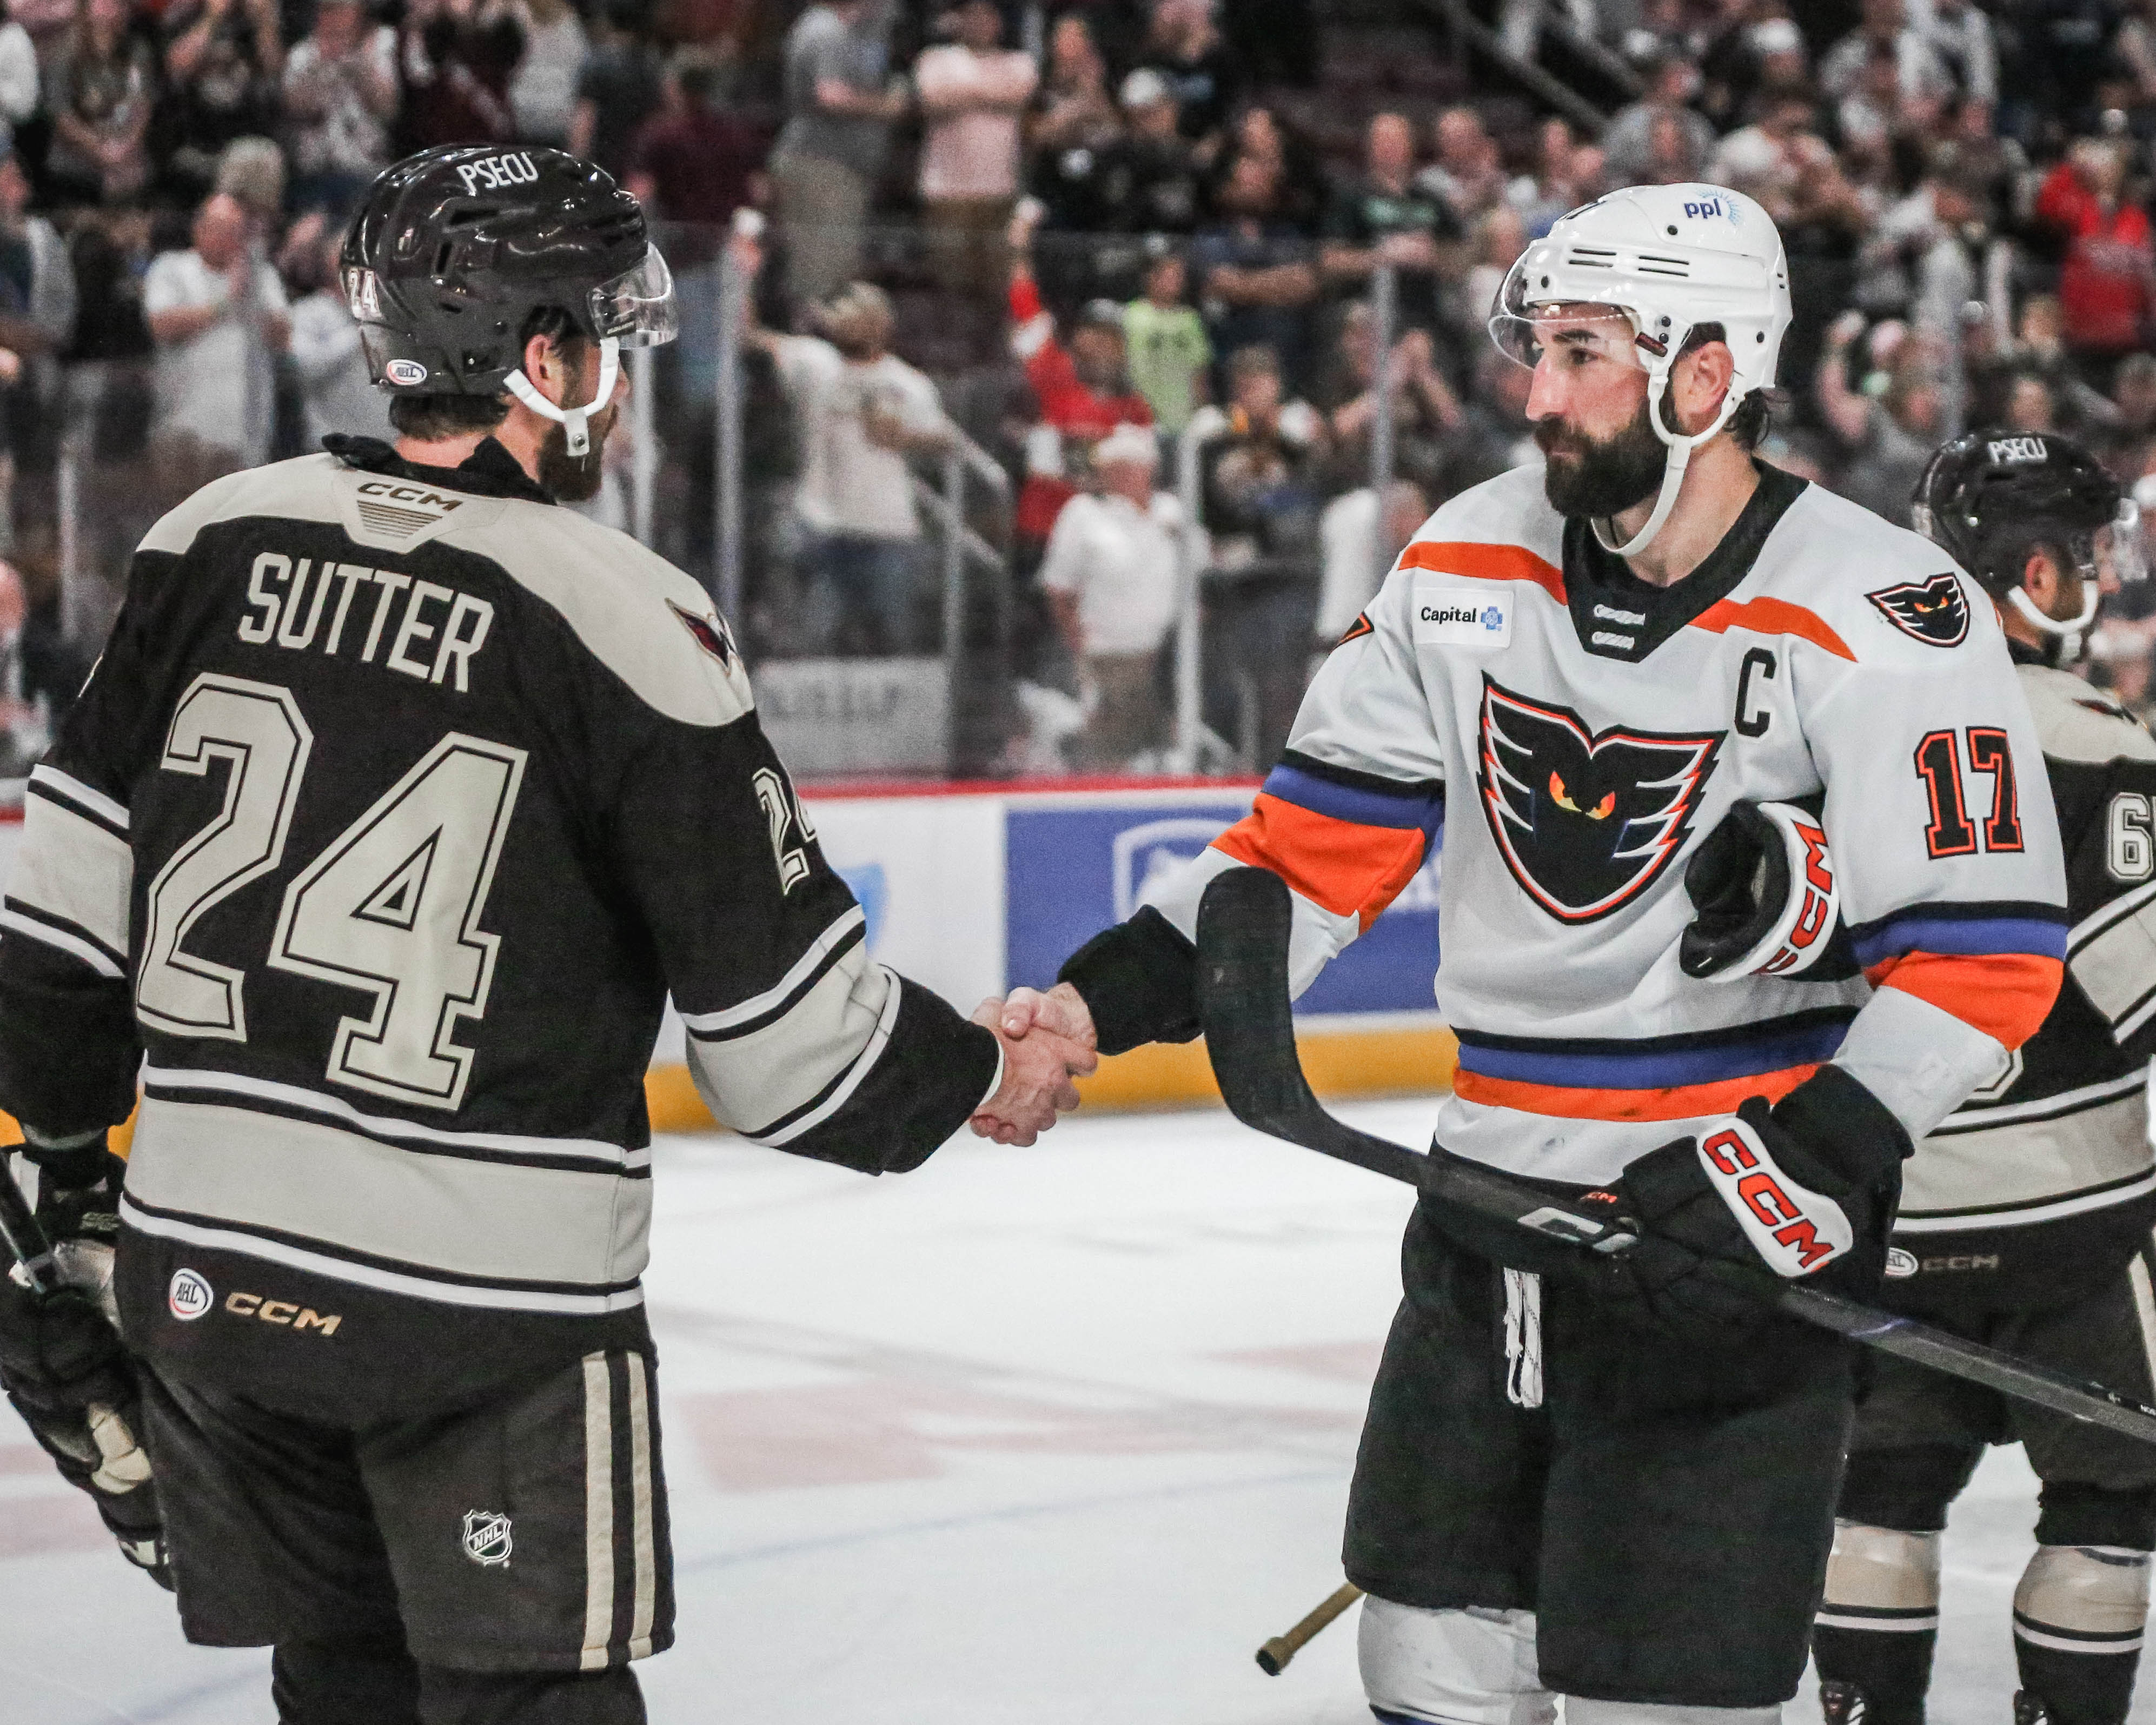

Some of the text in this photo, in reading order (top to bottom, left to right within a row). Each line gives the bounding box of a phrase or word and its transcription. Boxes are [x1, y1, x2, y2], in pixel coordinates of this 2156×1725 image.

[457, 152, 539, 196] PSECU
[1683, 198, 1721, 219] ppl
[348, 268, 382, 319] 24
[1987, 437, 2048, 465] PSECU
[357, 482, 463, 511] CCM
[238, 552, 495, 692] SUTTER
[1421, 606, 1477, 625] Capital
[1734, 647, 1776, 738] C
[1913, 725, 2025, 860] 17
[2108, 792, 2156, 880] 6
[137, 672, 529, 1111] 24
[1748, 819, 1833, 975] CCM
[1702, 1128, 1835, 1269] CCM
[1922, 1255, 2000, 1270] CCM
[177, 1282, 199, 1304] AHL
[225, 1292, 343, 1336] CCM
[474, 1525, 503, 1551] NHL
